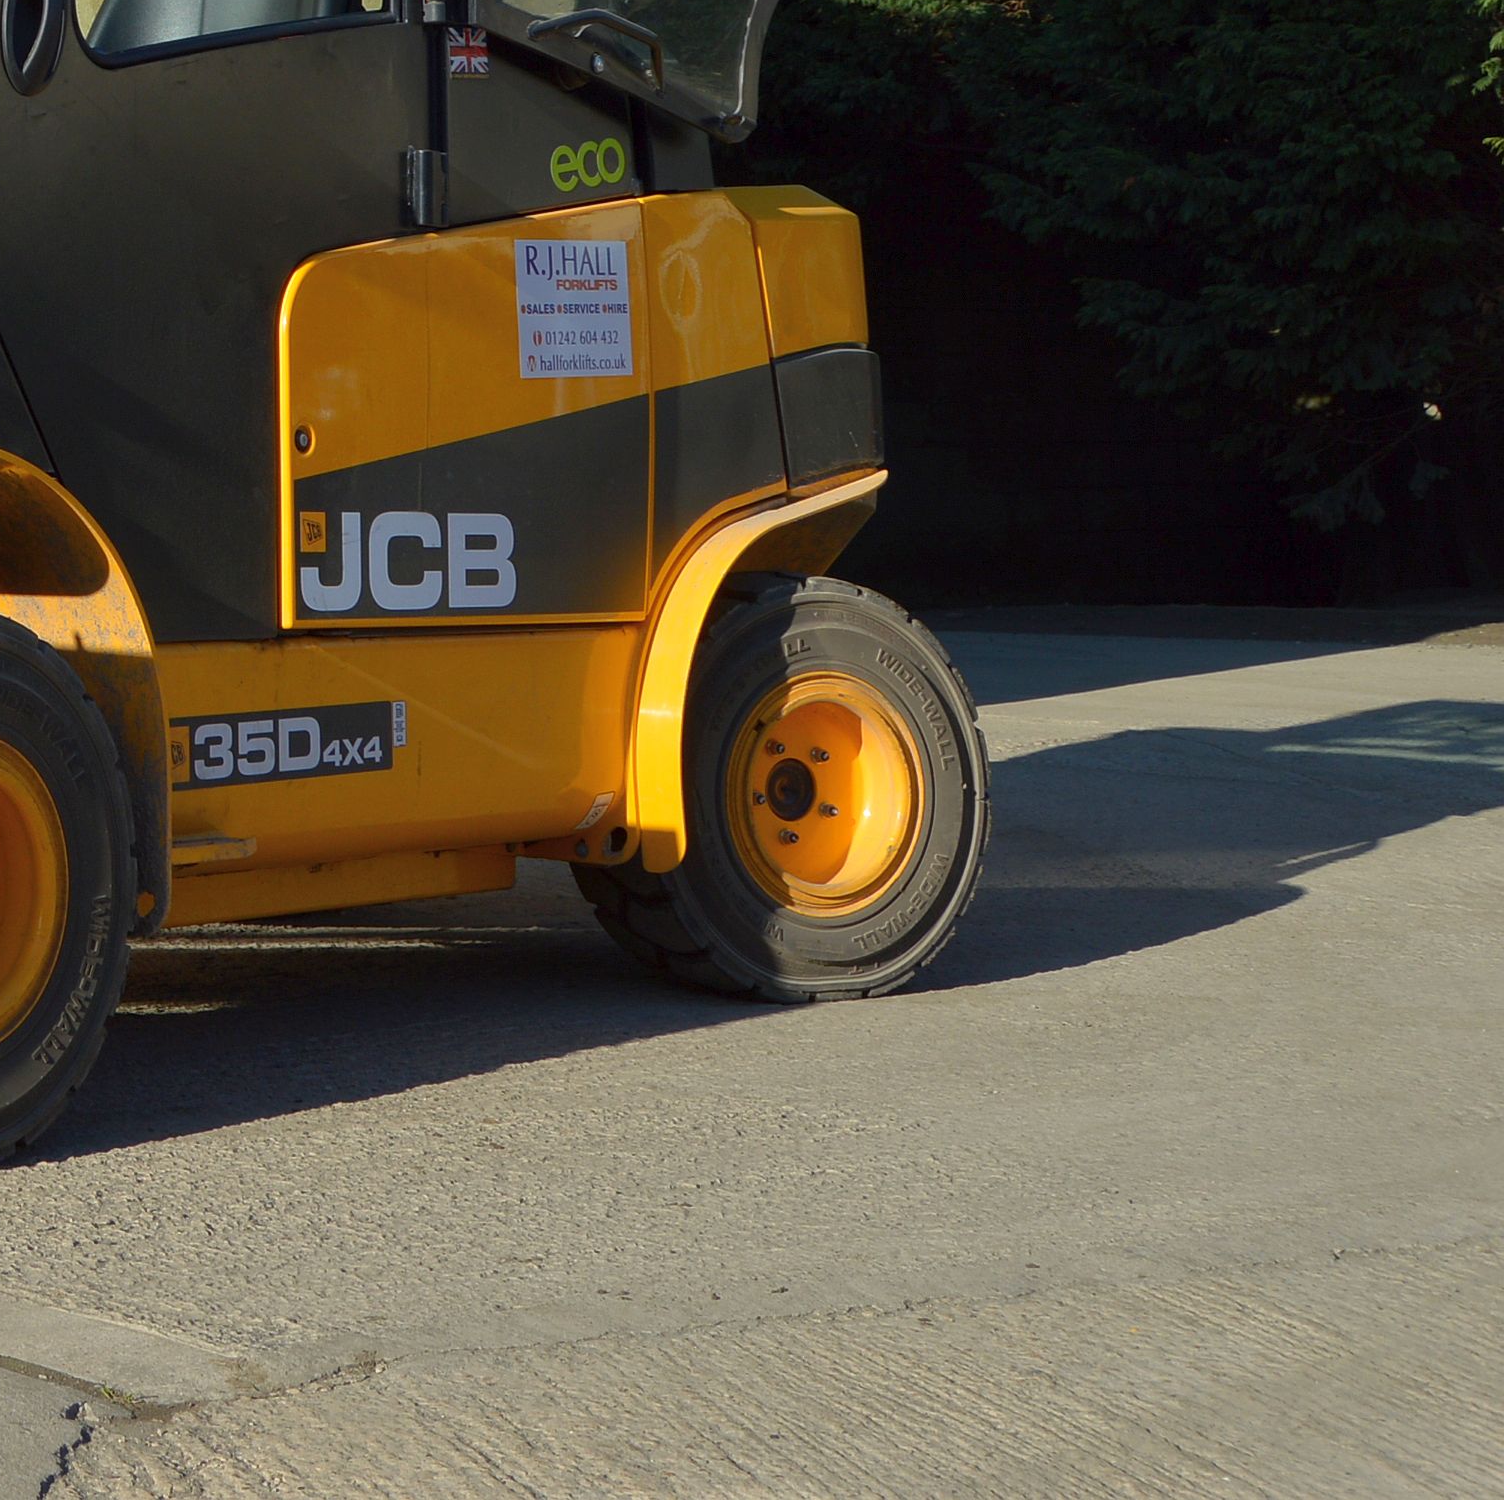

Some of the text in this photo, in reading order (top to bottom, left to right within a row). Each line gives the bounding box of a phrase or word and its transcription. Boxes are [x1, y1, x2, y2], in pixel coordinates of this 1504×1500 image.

[550, 137, 626, 192] eco
[525, 245, 618, 280] R.J.HALL
[556, 278, 618, 291] FORKLIFTS
[526, 303, 628, 315] SALES SERVICE HIRE
[545, 329, 619, 345] 01242 604 432
[539, 354, 627, 372] hallforklifts.co.uk
[305, 520, 322, 543] JCB
[299, 510, 517, 612] JCB
[876, 647, 959, 772] WIDE-WALL
[193, 716, 321, 781] 35D
